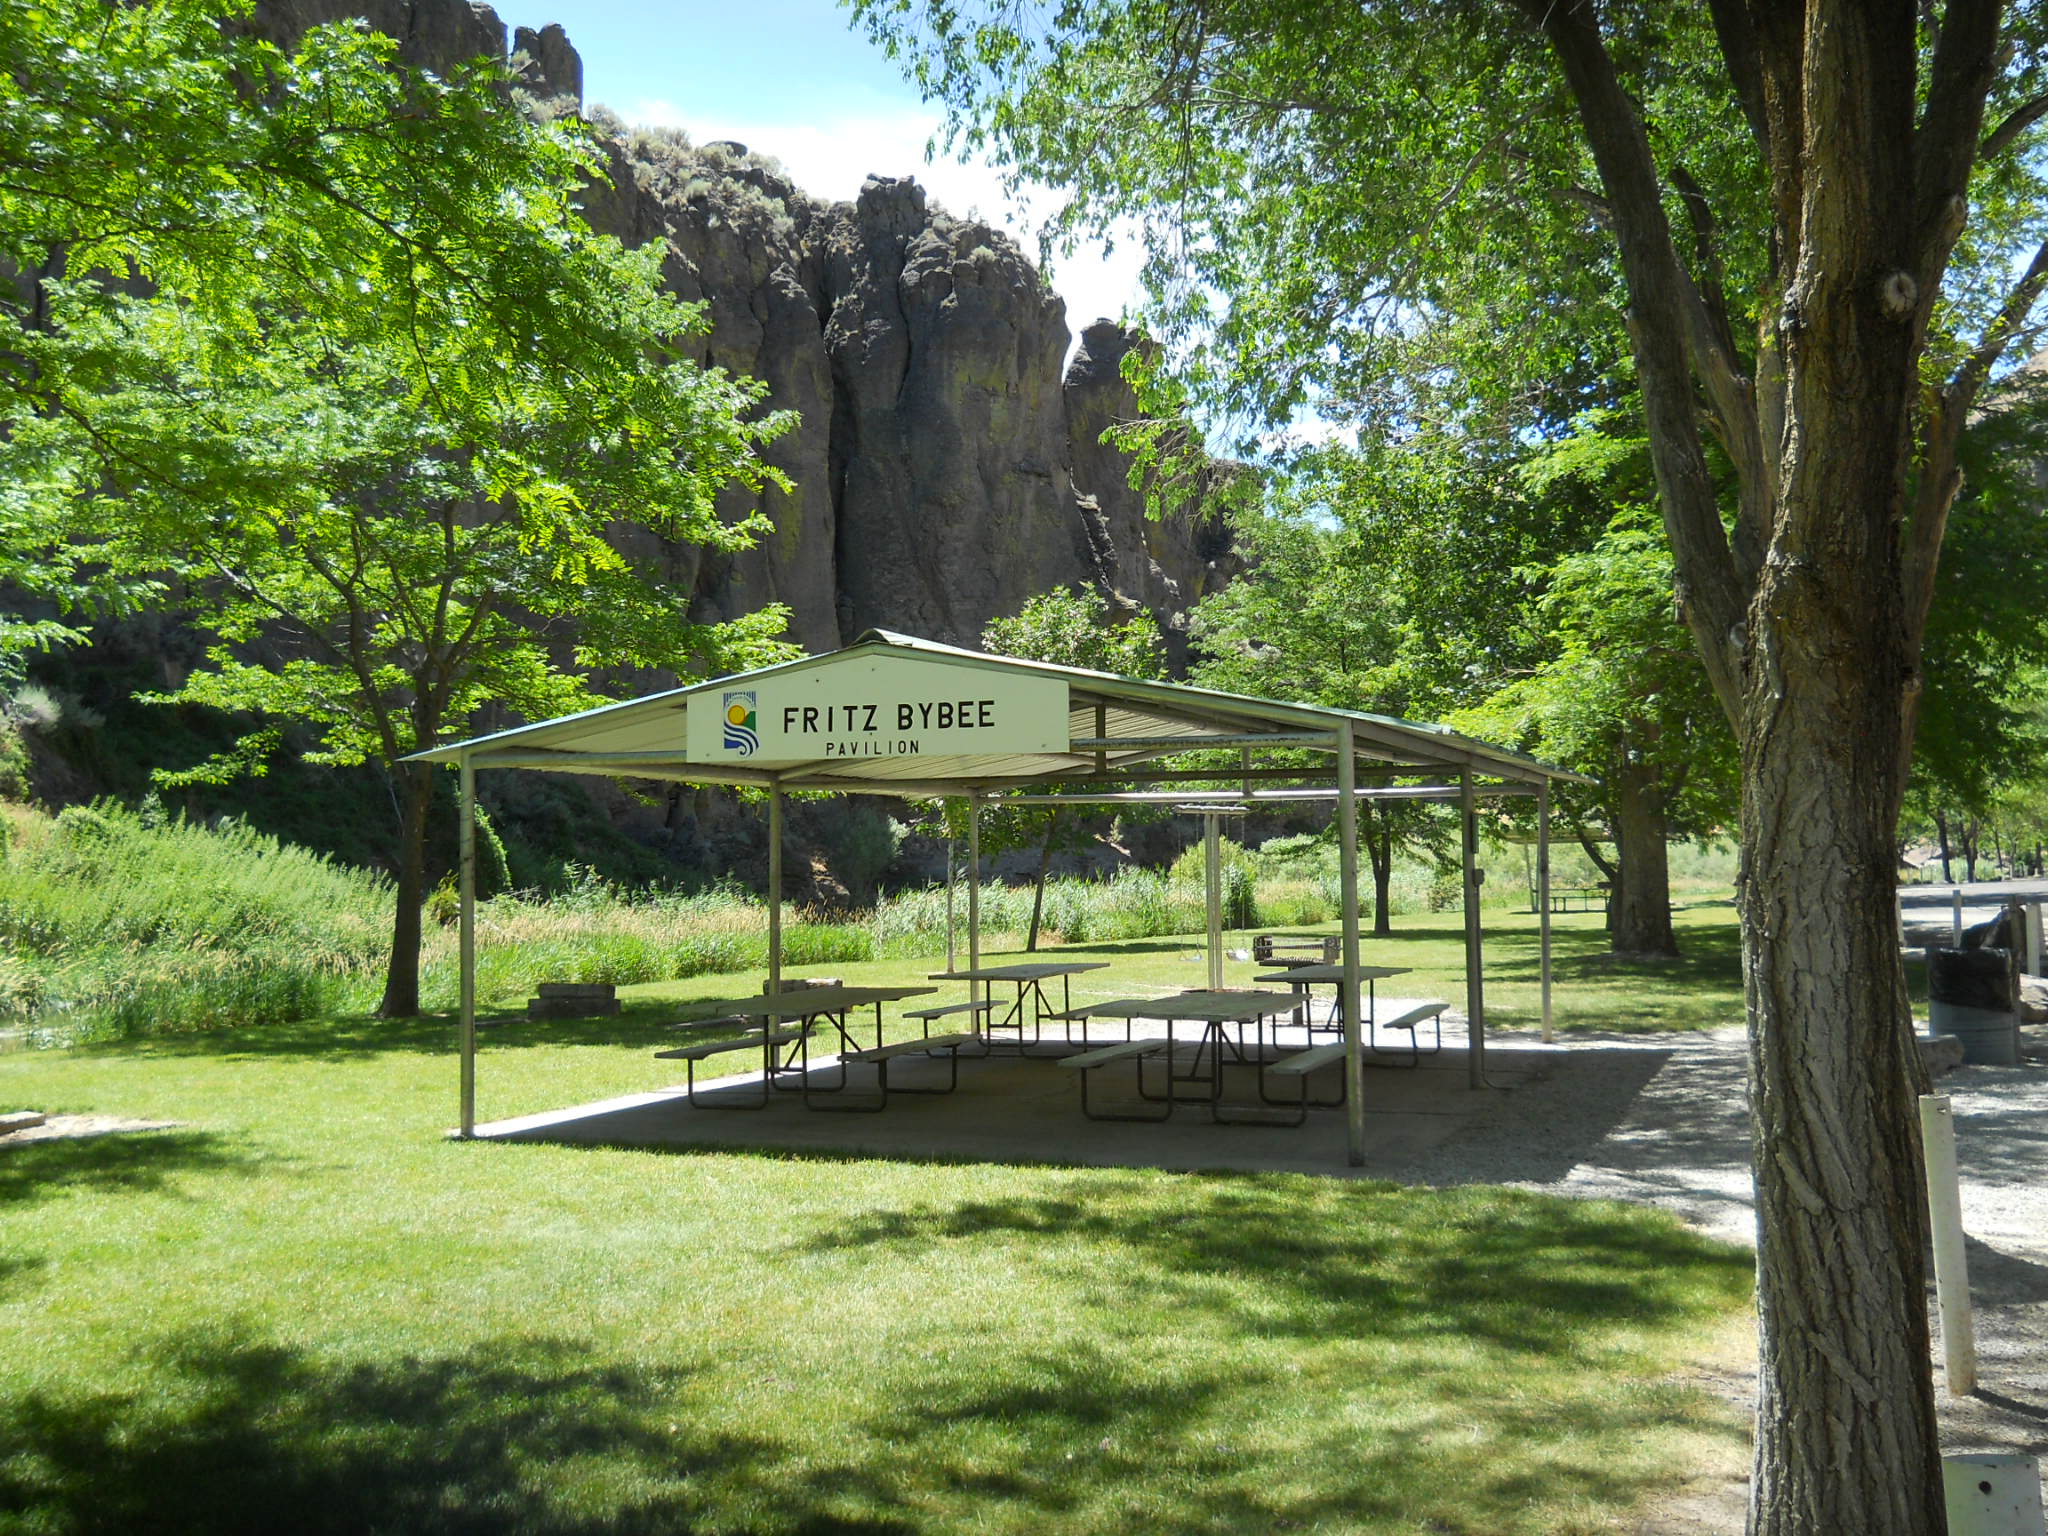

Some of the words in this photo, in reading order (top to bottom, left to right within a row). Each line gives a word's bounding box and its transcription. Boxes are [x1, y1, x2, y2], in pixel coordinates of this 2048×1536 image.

[783, 704, 878, 733] FRITZ
[897, 700, 995, 731] BYBEE
[826, 740, 919, 756] PAVILION
